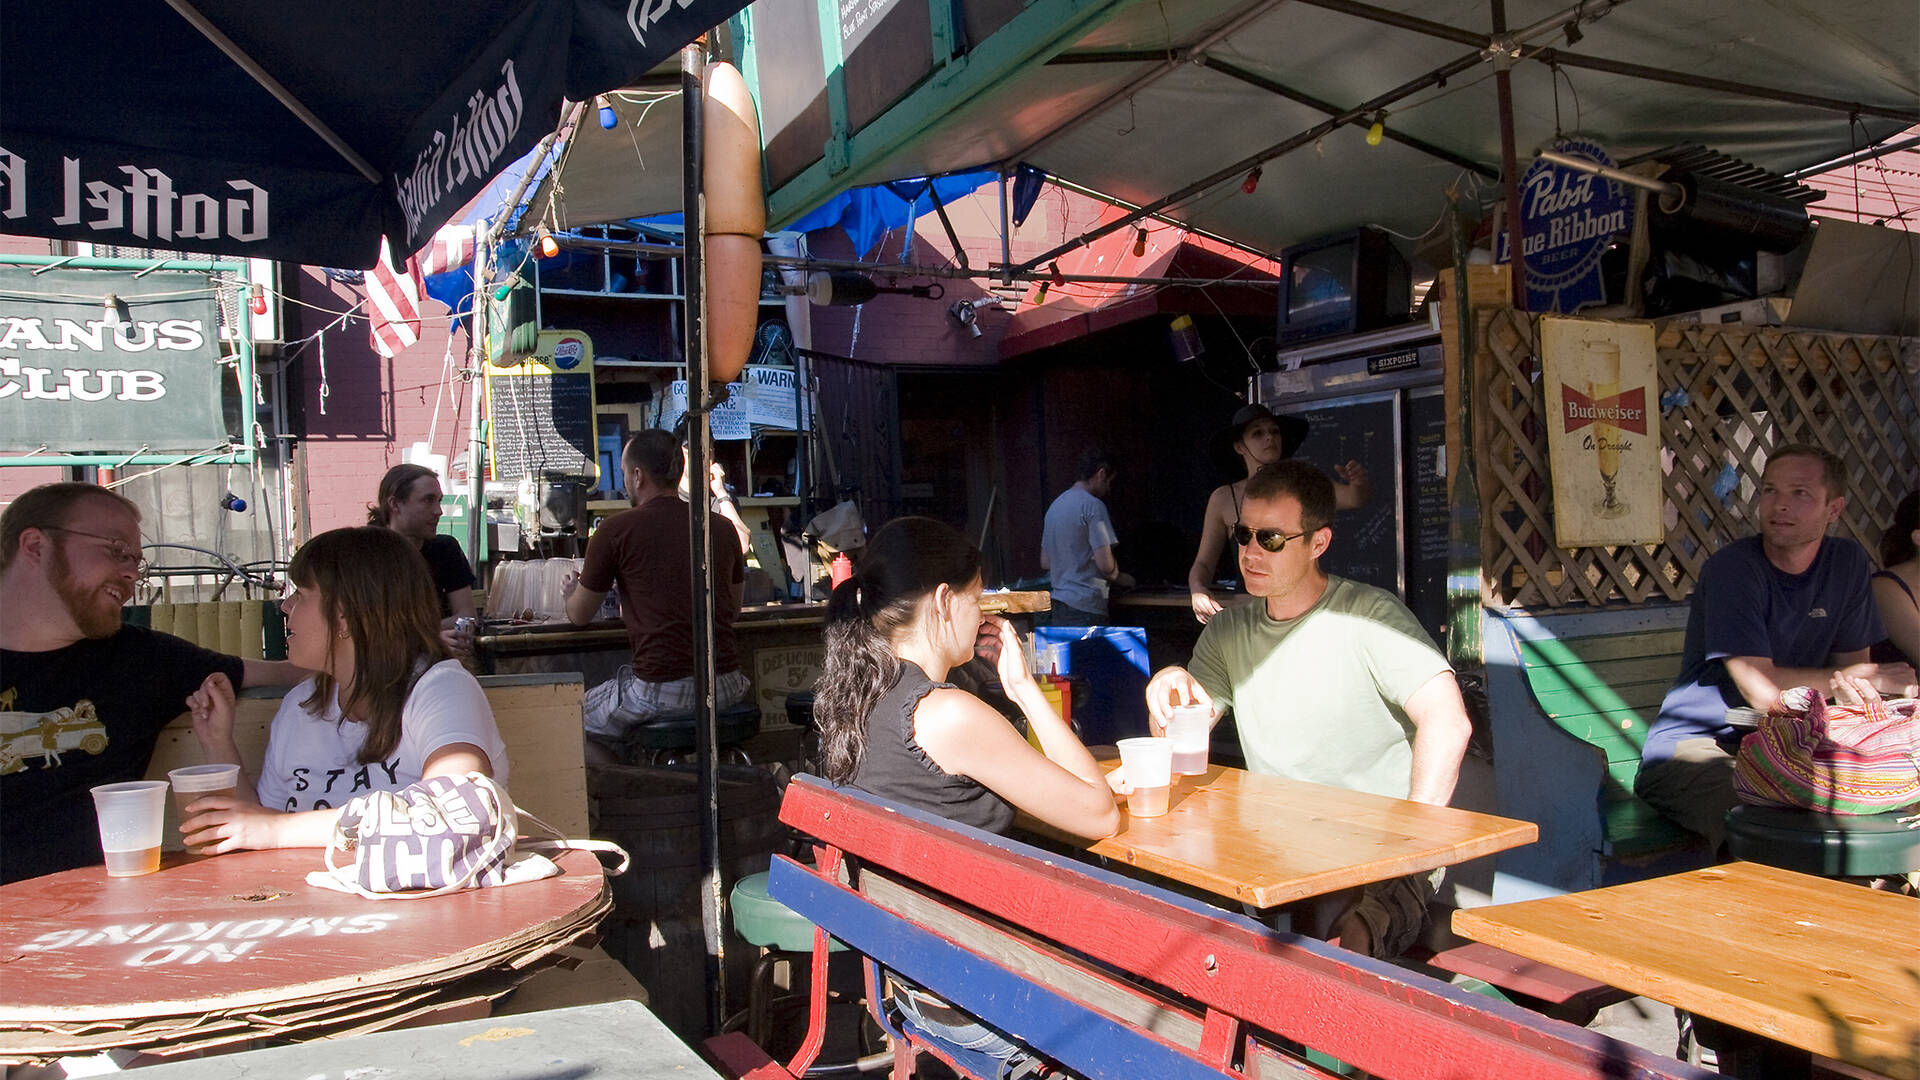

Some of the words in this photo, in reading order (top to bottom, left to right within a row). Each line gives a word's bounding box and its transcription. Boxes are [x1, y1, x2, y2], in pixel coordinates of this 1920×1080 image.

[1527, 170, 1595, 220] Pabst
[1500, 231, 1546, 262] Bue
[1548, 208, 1626, 249] Ribbon
[1541, 247, 1580, 266] BEER
[0, 317, 205, 352] ANUS
[757, 370, 796, 388] WARN
[1568, 401, 1643, 420] Budweiser
[1582, 434, 1596, 450] On
[292, 757, 400, 793] STAY
[17, 912, 401, 953] SMOKING
[124, 940, 260, 968] NO
